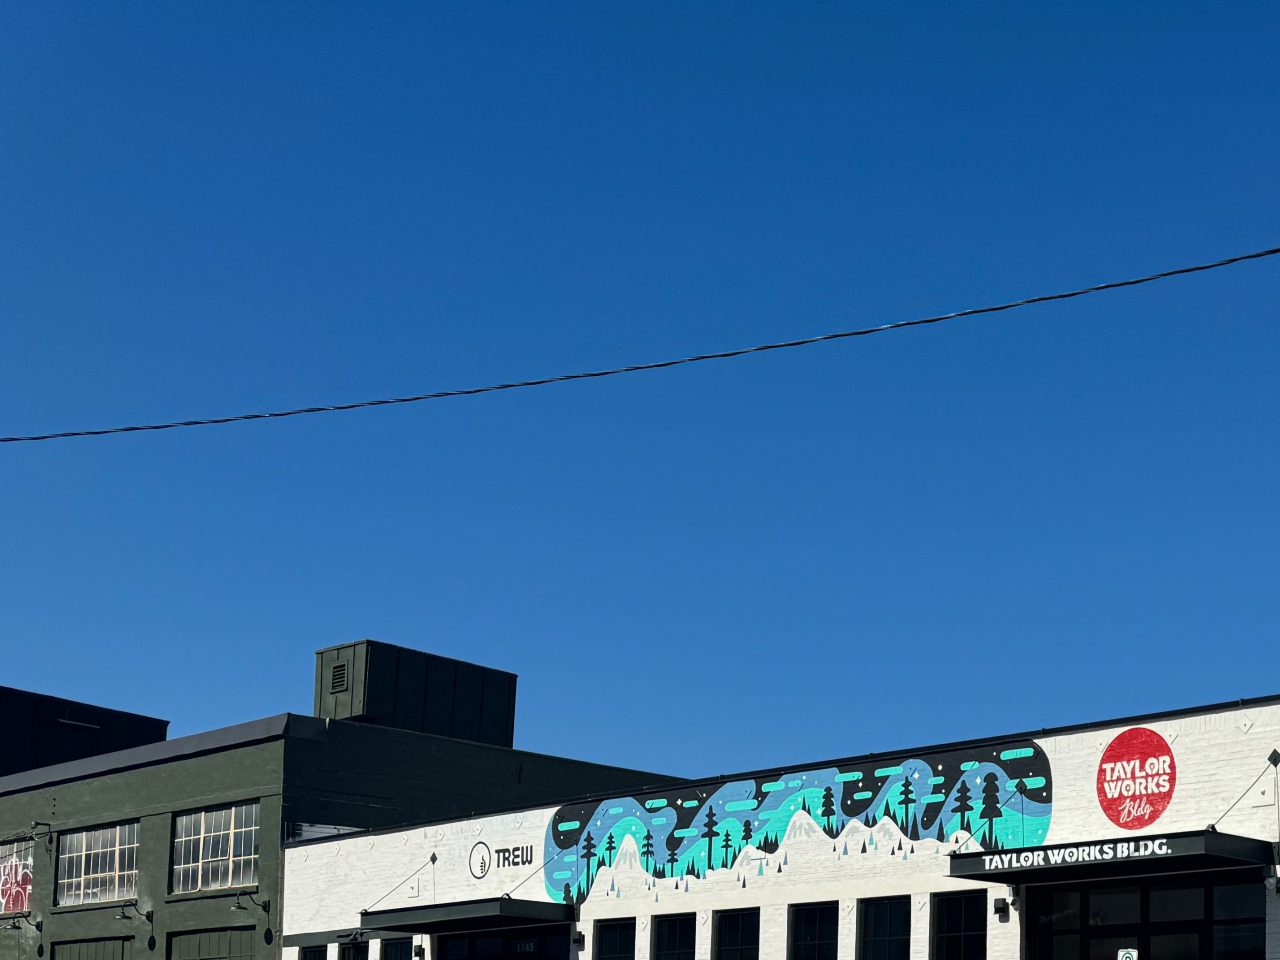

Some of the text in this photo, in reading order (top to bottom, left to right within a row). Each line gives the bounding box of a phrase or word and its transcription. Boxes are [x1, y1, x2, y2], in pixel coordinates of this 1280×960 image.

[1102, 755, 1171, 780] TAYLOR
[1103, 774, 1170, 799] WORKS
[495, 845, 533, 868] TREW
[982, 838, 1172, 871] TAYLOR WORKS BLDG.
[516, 942, 535, 953] 1145
